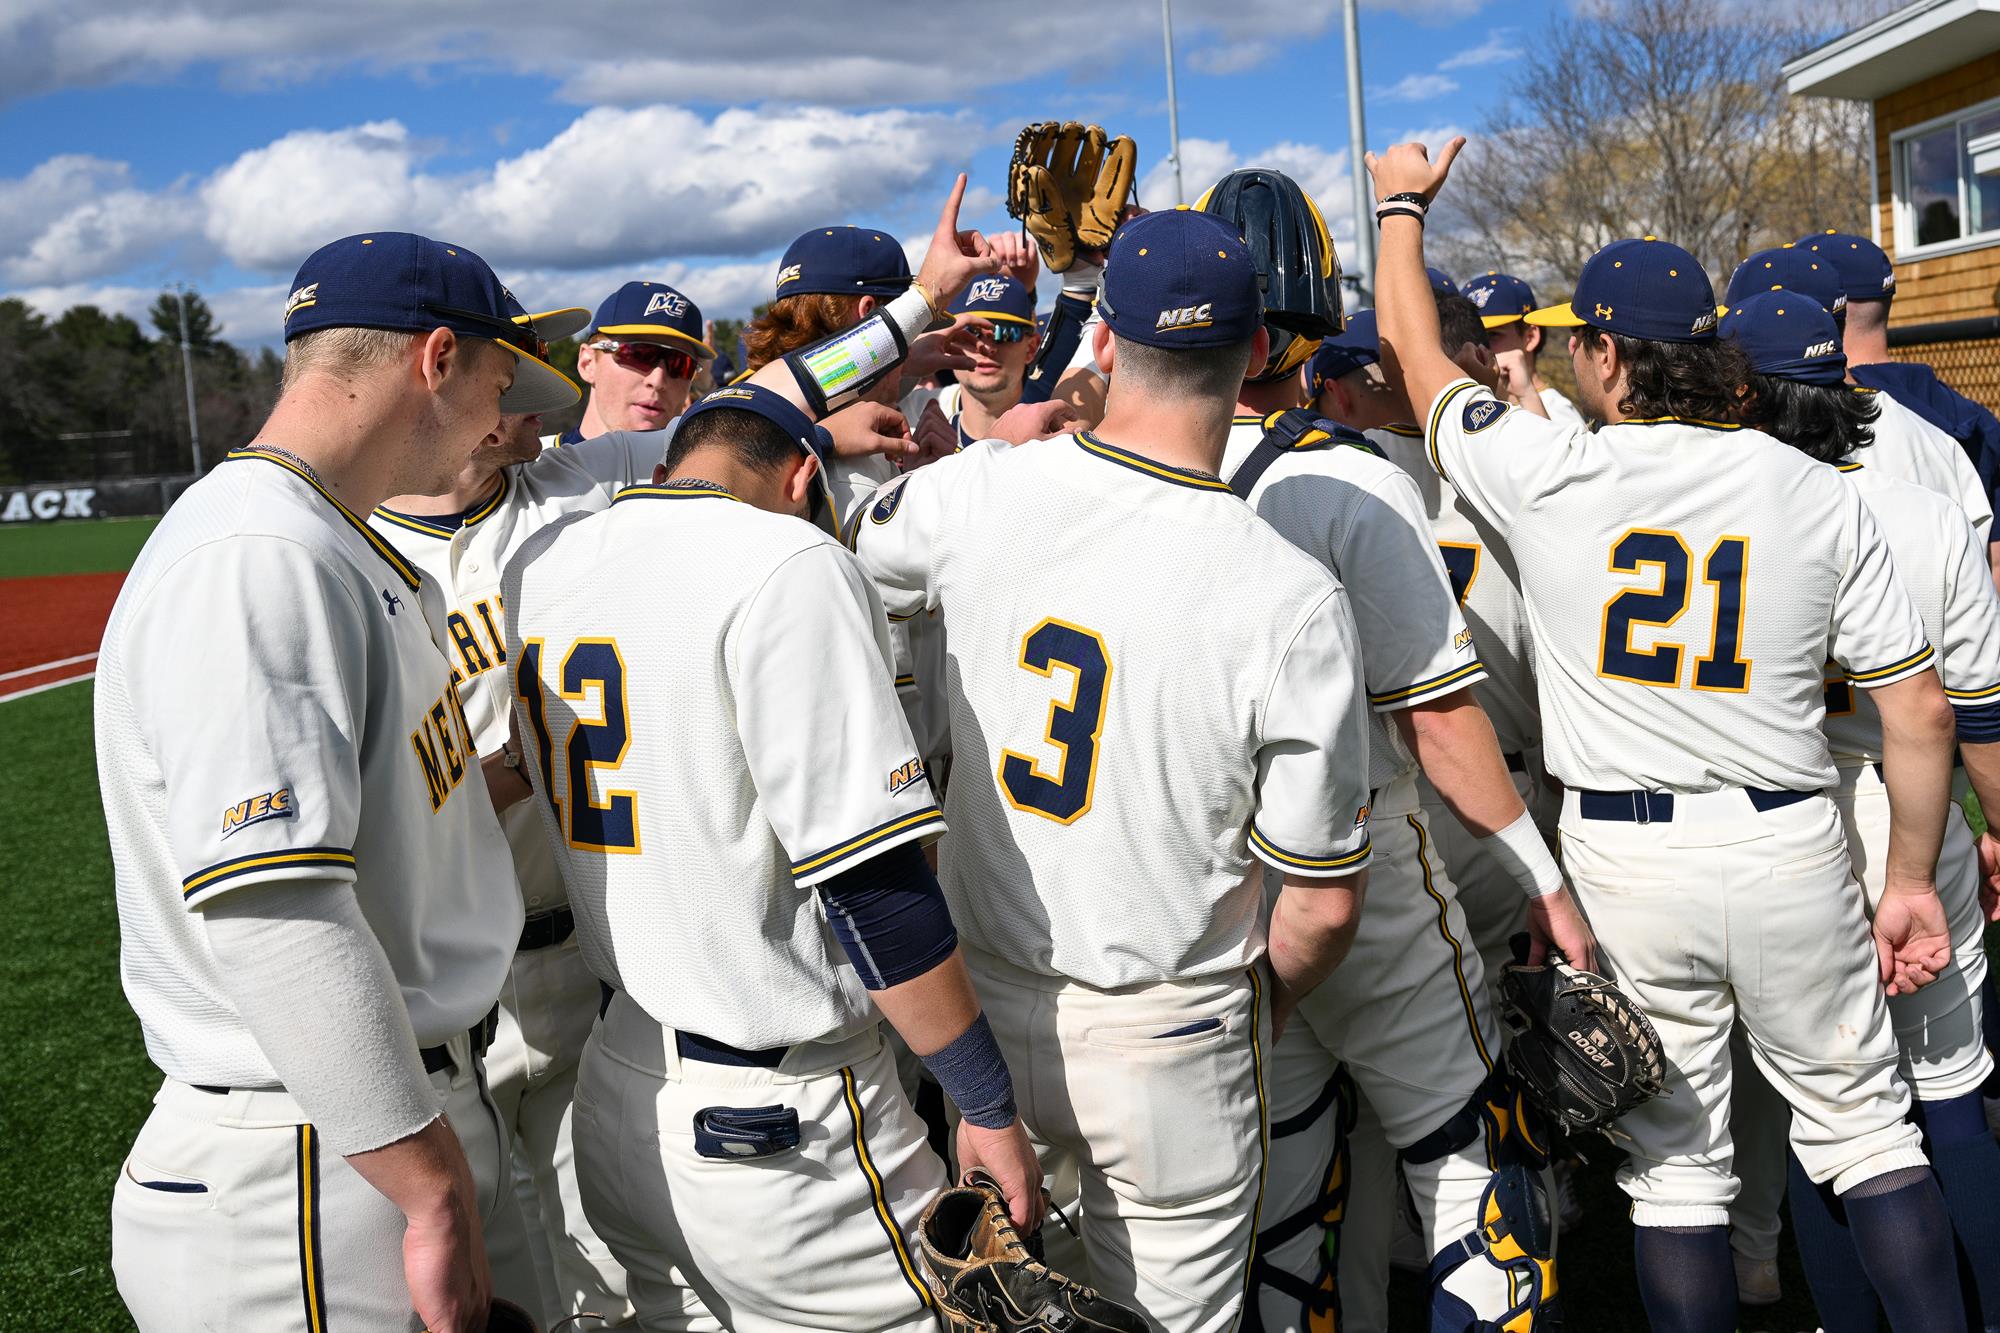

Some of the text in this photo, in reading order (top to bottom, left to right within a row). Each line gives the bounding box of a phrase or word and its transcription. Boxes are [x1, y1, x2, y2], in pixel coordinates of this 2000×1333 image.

[643, 292, 688, 318] MC
[964, 278, 1010, 306] MC
[1155, 302, 1213, 328] NEC
[1803, 340, 1836, 359] NEC
[0, 488, 96, 522] ACK
[1596, 526, 1753, 694] 21
[997, 615, 1114, 827] 3
[514, 636, 643, 855] 12
[890, 756, 923, 793] NE
[222, 788, 290, 834] NEC
[1627, 1001, 1659, 1048] Wilson
[1567, 1030, 1616, 1068] A2000
